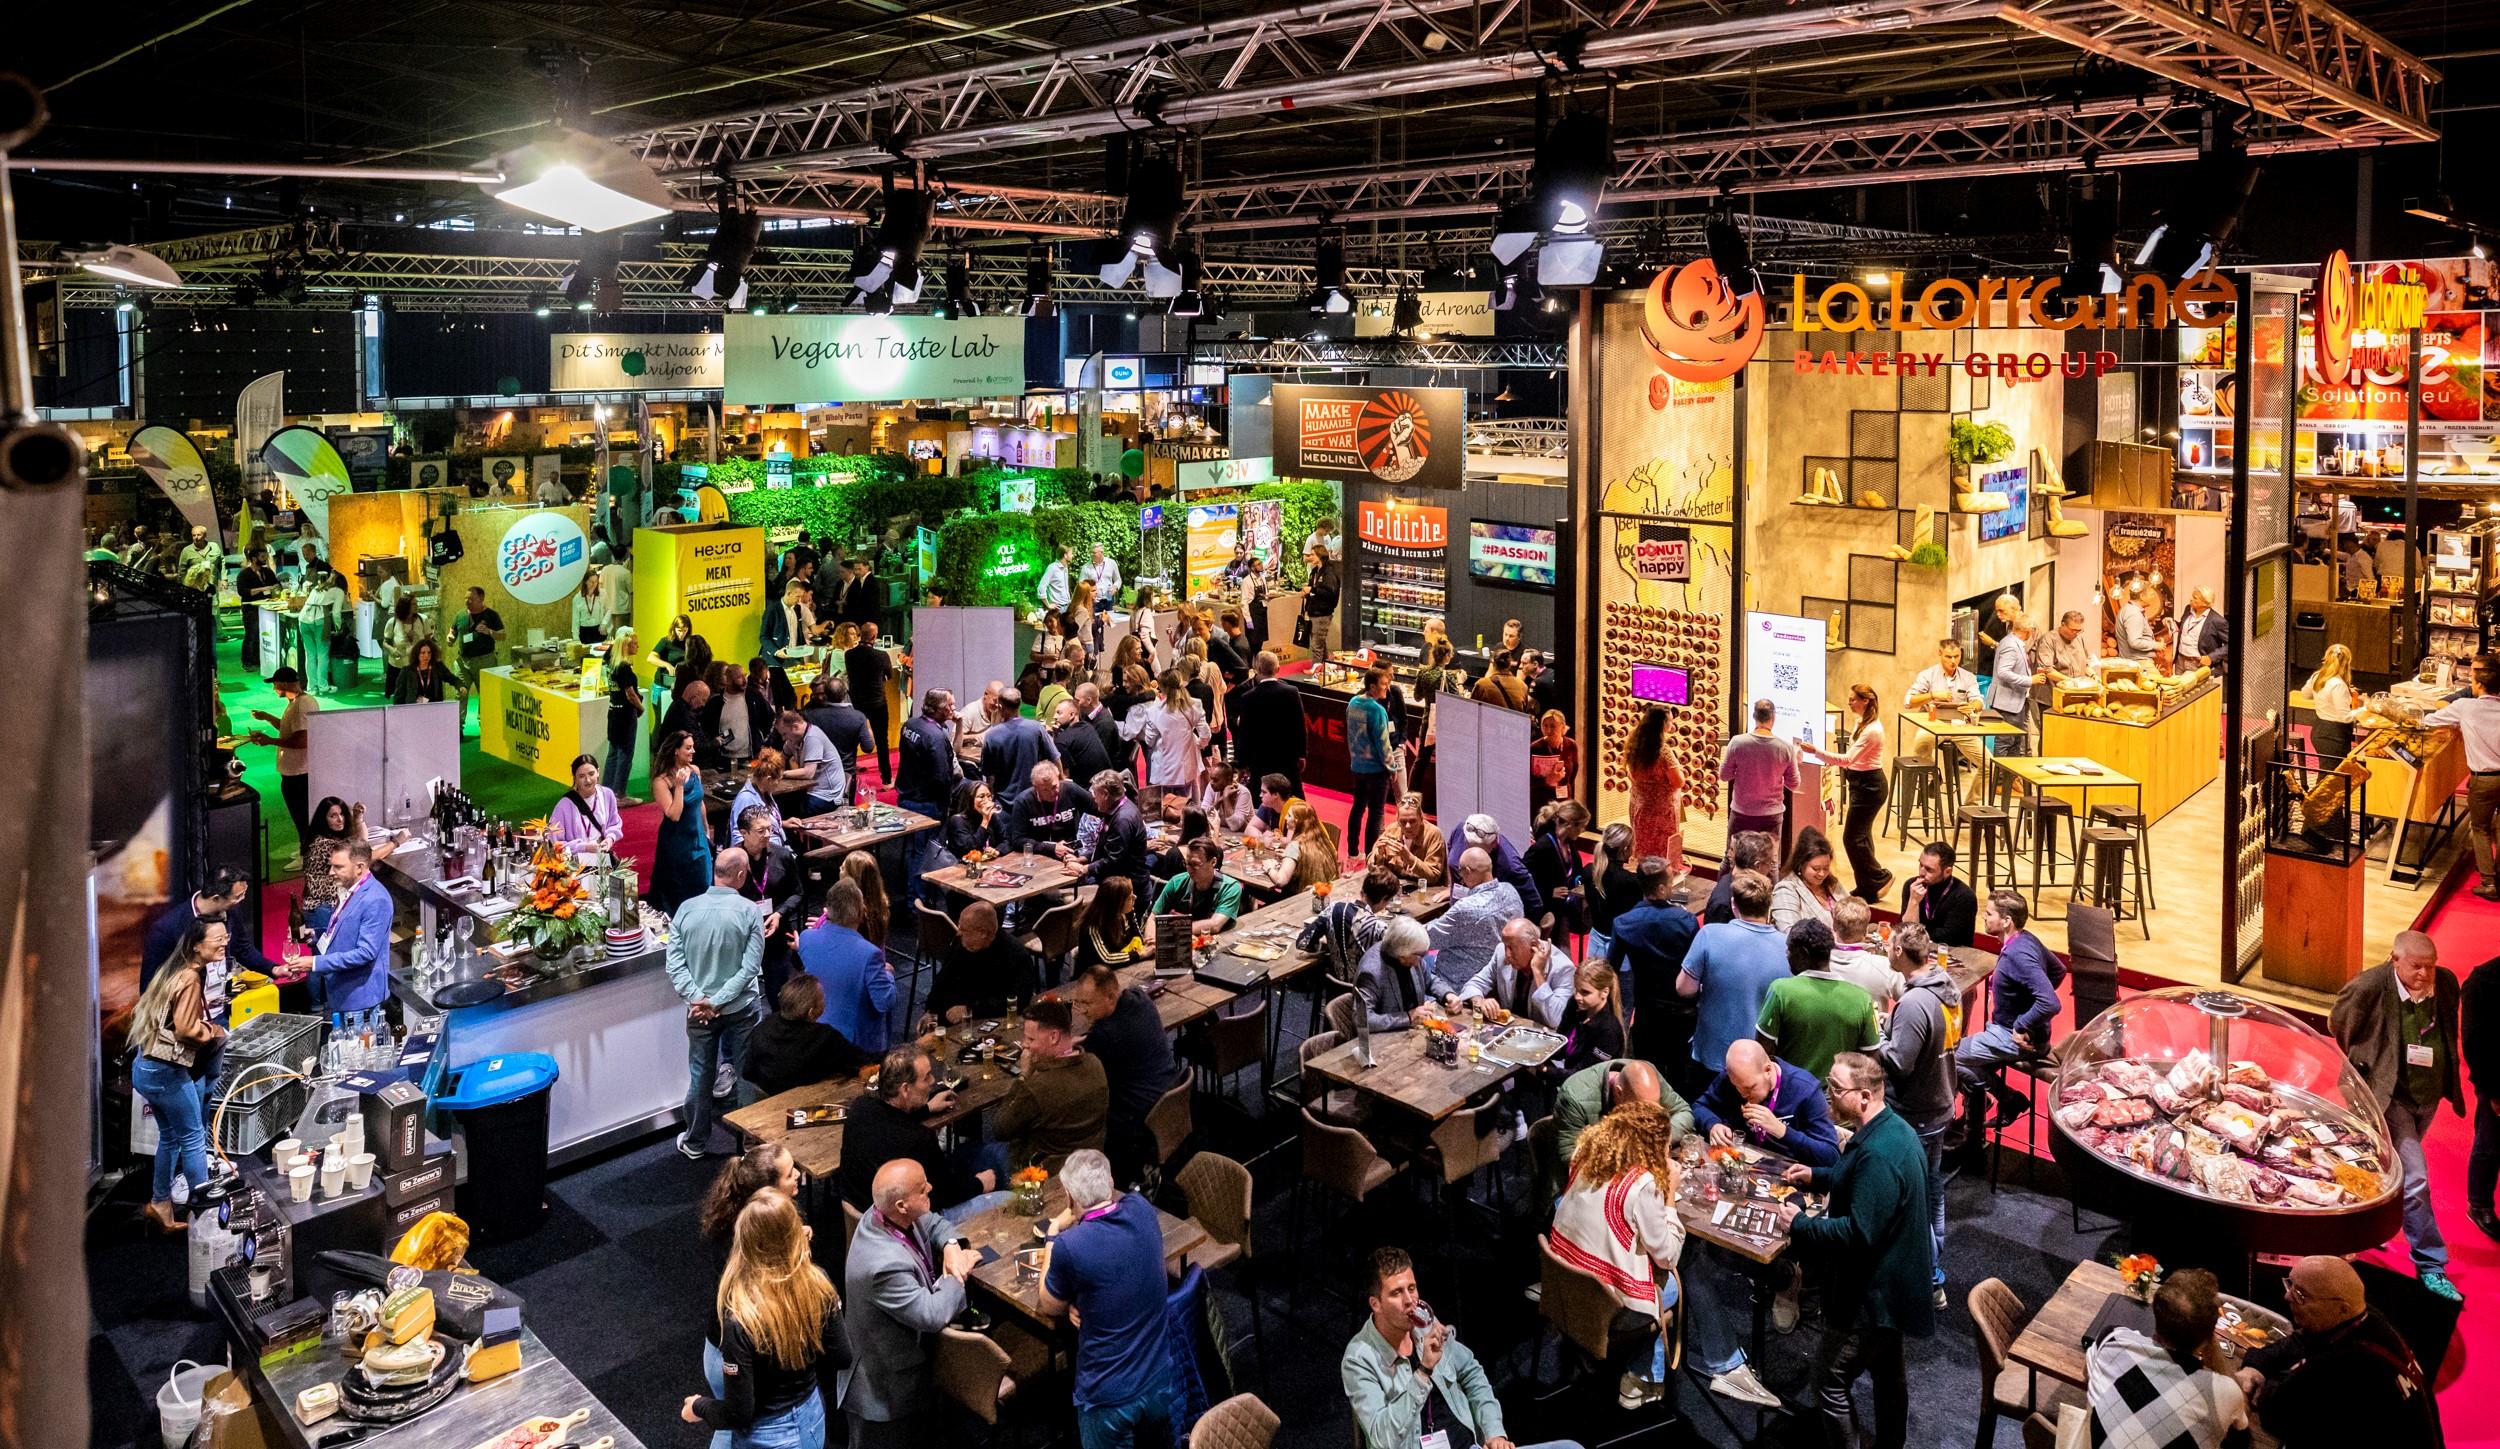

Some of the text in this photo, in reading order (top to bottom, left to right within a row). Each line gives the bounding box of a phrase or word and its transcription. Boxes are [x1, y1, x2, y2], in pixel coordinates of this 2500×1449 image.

[1436, 302, 1489, 316] Arena
[2390, 332, 2452, 346] COEPTS
[561, 343, 592, 359] Dit
[666, 344, 711, 357] Naar
[771, 334, 1000, 369] Vegan Taste Lab
[644, 362, 707, 381] viljoen
[1793, 349, 2118, 378] BAKERY GROUP
[1305, 403, 1351, 420] MAKE
[1305, 418, 1353, 432] HUMMUS
[1305, 434, 1353, 448] NOT WAR
[1694, 500, 1724, 518] better
[1361, 510, 1445, 543] Deldiche
[504, 533, 539, 555] SEA
[1362, 541, 1445, 558] where food becomes art
[1481, 542, 1549, 562] #PASSION
[1637, 543, 1683, 557] DONUT
[504, 551, 532, 571] SO
[1639, 560, 1685, 575] happy
[504, 559, 554, 586] GOOD
[706, 565, 732, 580] MEAT
[687, 577, 752, 597] ALTERNATIVE
[688, 592, 751, 612] SUCCESSORS
[511, 690, 543, 718] WELCOME
[506, 709, 550, 742] MEAT LOVERS
[406, 1126, 415, 1155] Zeeuw's
[402, 1170, 441, 1190] De Zeeuw's
[399, 1199, 439, 1220] De Zeeuw's
